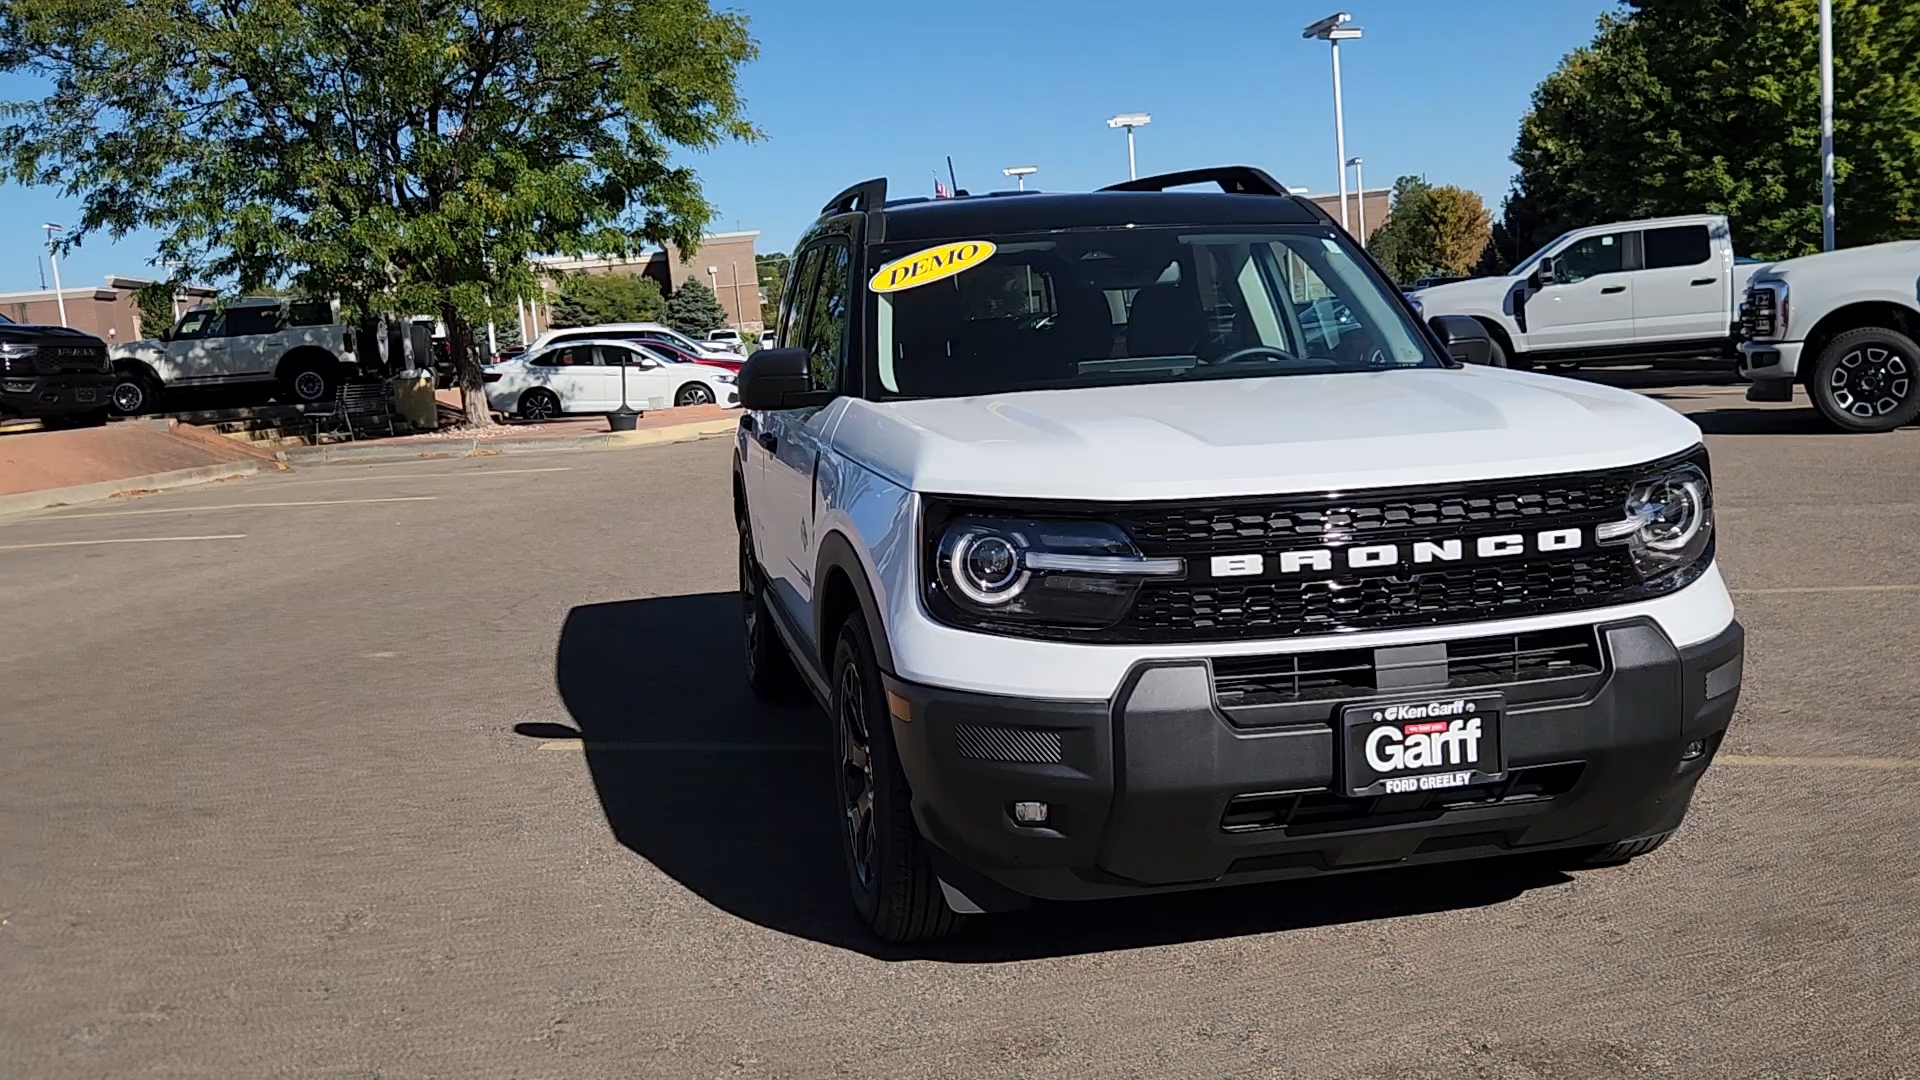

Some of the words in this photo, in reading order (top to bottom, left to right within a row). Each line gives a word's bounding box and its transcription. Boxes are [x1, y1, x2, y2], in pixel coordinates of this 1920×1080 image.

[887, 244, 979, 288] DEMO
[1210, 528, 1583, 577] BRONCO
[1397, 705, 1427, 720] Ken
[1427, 700, 1465, 717] Garff
[1365, 718, 1482, 772] Garff
[1385, 779, 1417, 794] FORD
[1419, 773, 1471, 790] GREELEY
